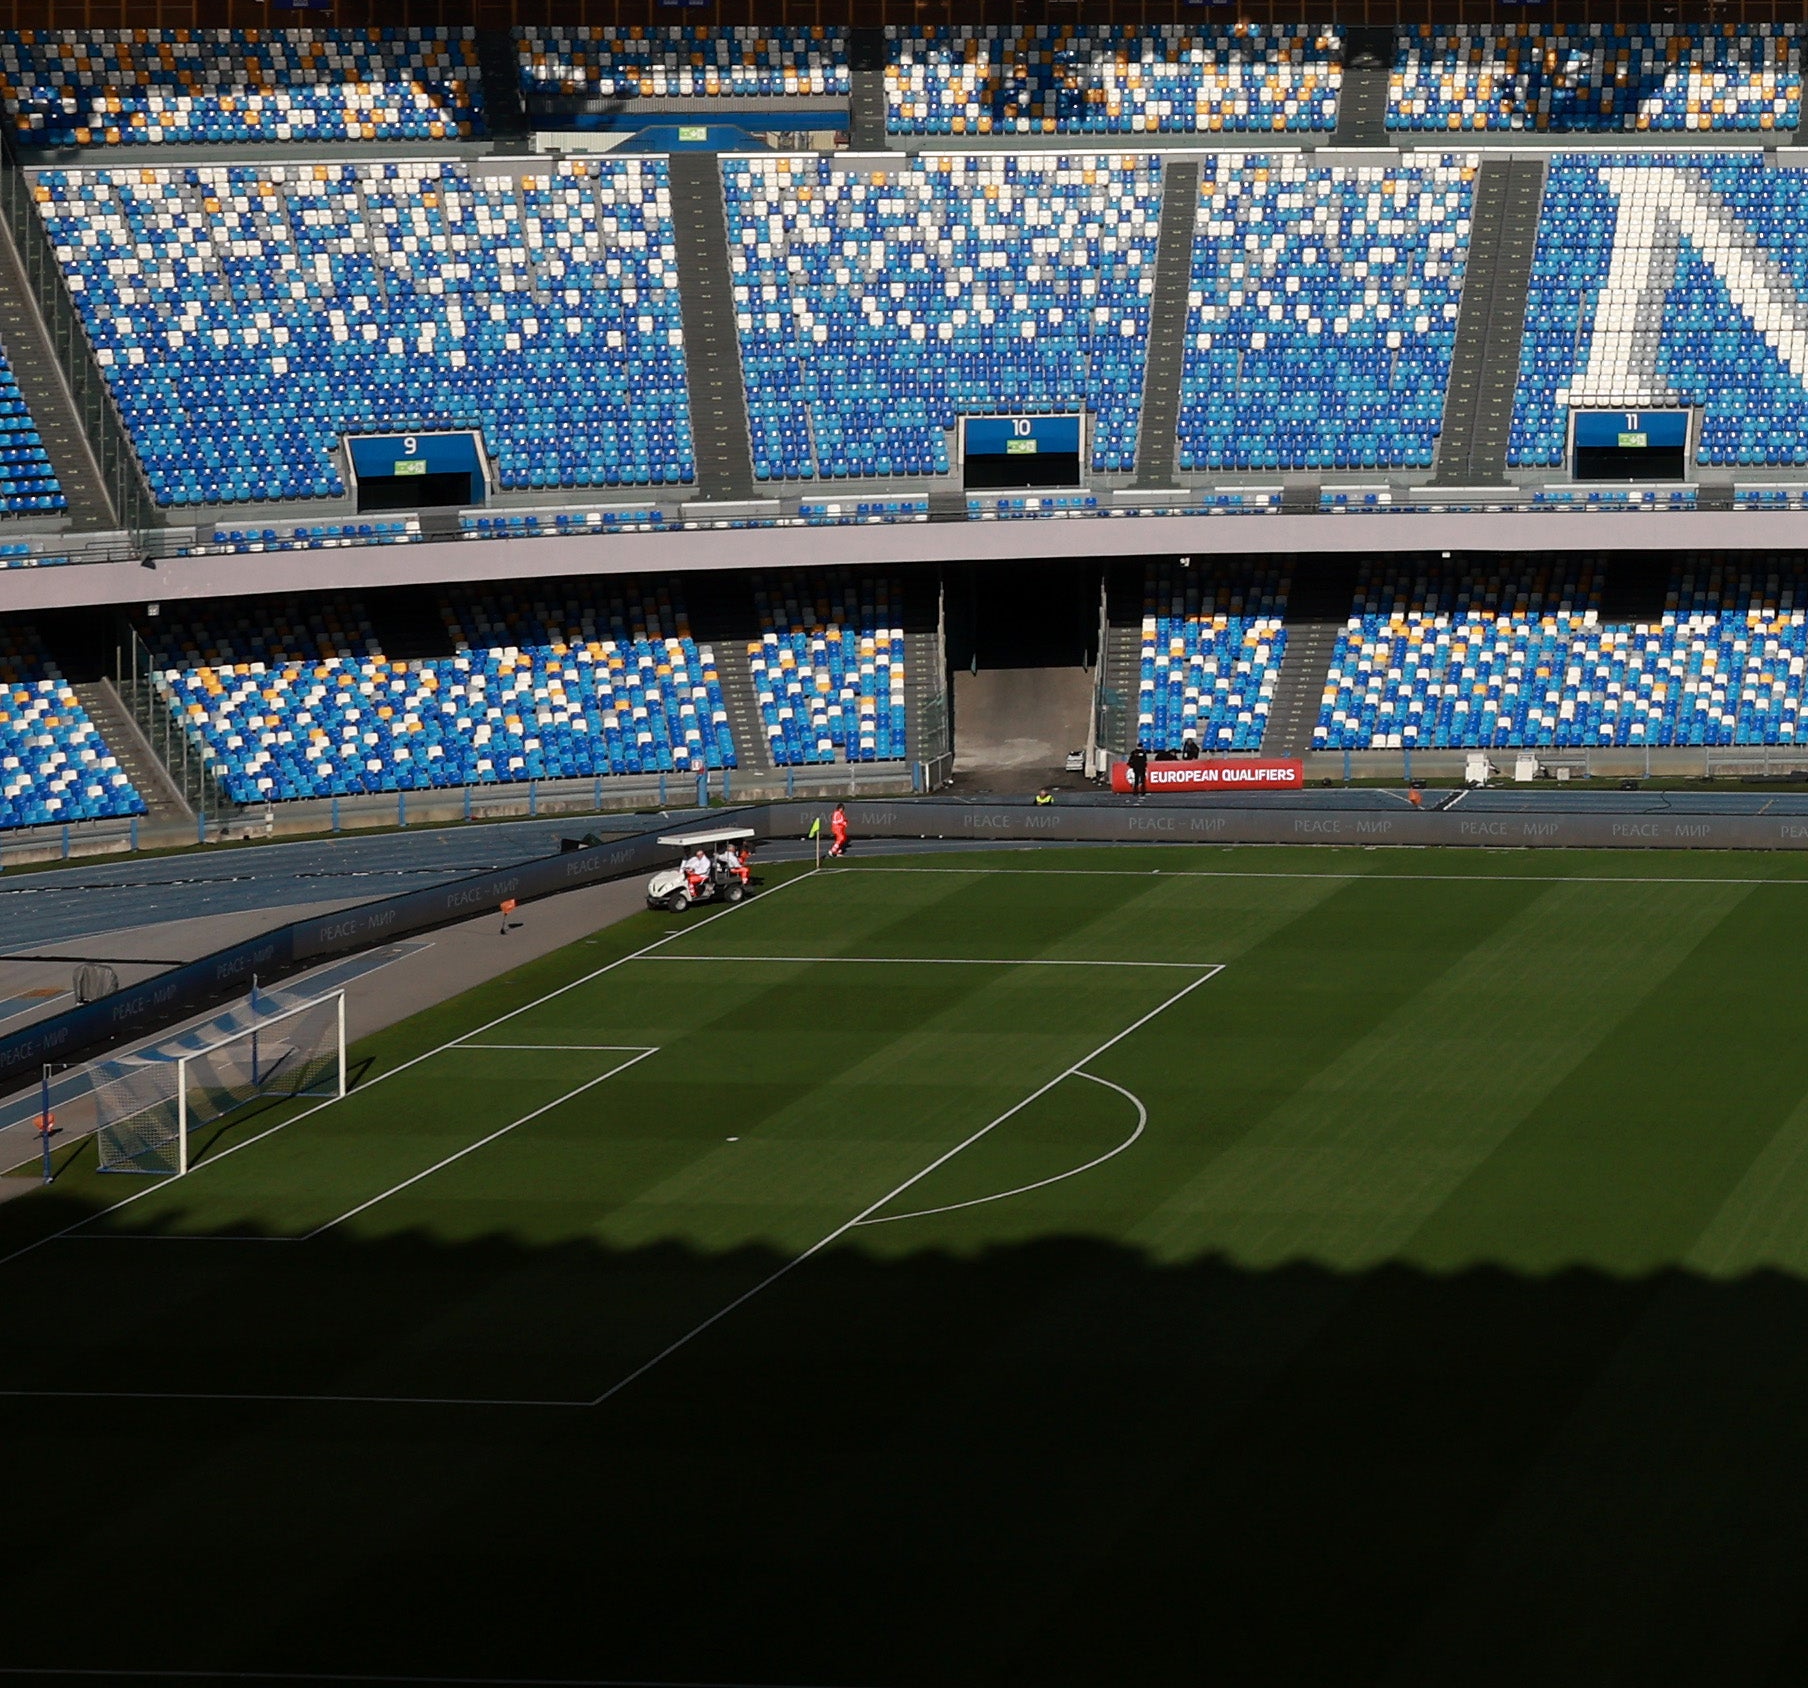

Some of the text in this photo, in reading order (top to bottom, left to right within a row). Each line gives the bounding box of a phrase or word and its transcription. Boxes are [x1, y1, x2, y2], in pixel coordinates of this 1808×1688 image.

[1012, 419, 1031, 436] 10
[1625, 414, 1638, 430] 11
[403, 437, 417, 455] 9
[1150, 768, 1295, 783] EUROPEAN QUALIFIERS
[964, 814, 1010, 828] PEACE
[1129, 817, 1174, 830] PEACE
[1295, 820, 1340, 833] PEACE
[1461, 821, 1507, 835] PEACE
[1613, 823, 1659, 836] PEACE
[567, 856, 601, 877] PEACE
[447, 887, 482, 908] PEACE
[320, 920, 357, 942] PEACE
[217, 956, 245, 979] PEACE
[113, 997, 144, 1021] PEACE
[0, 1041, 34, 1068] PEACE
